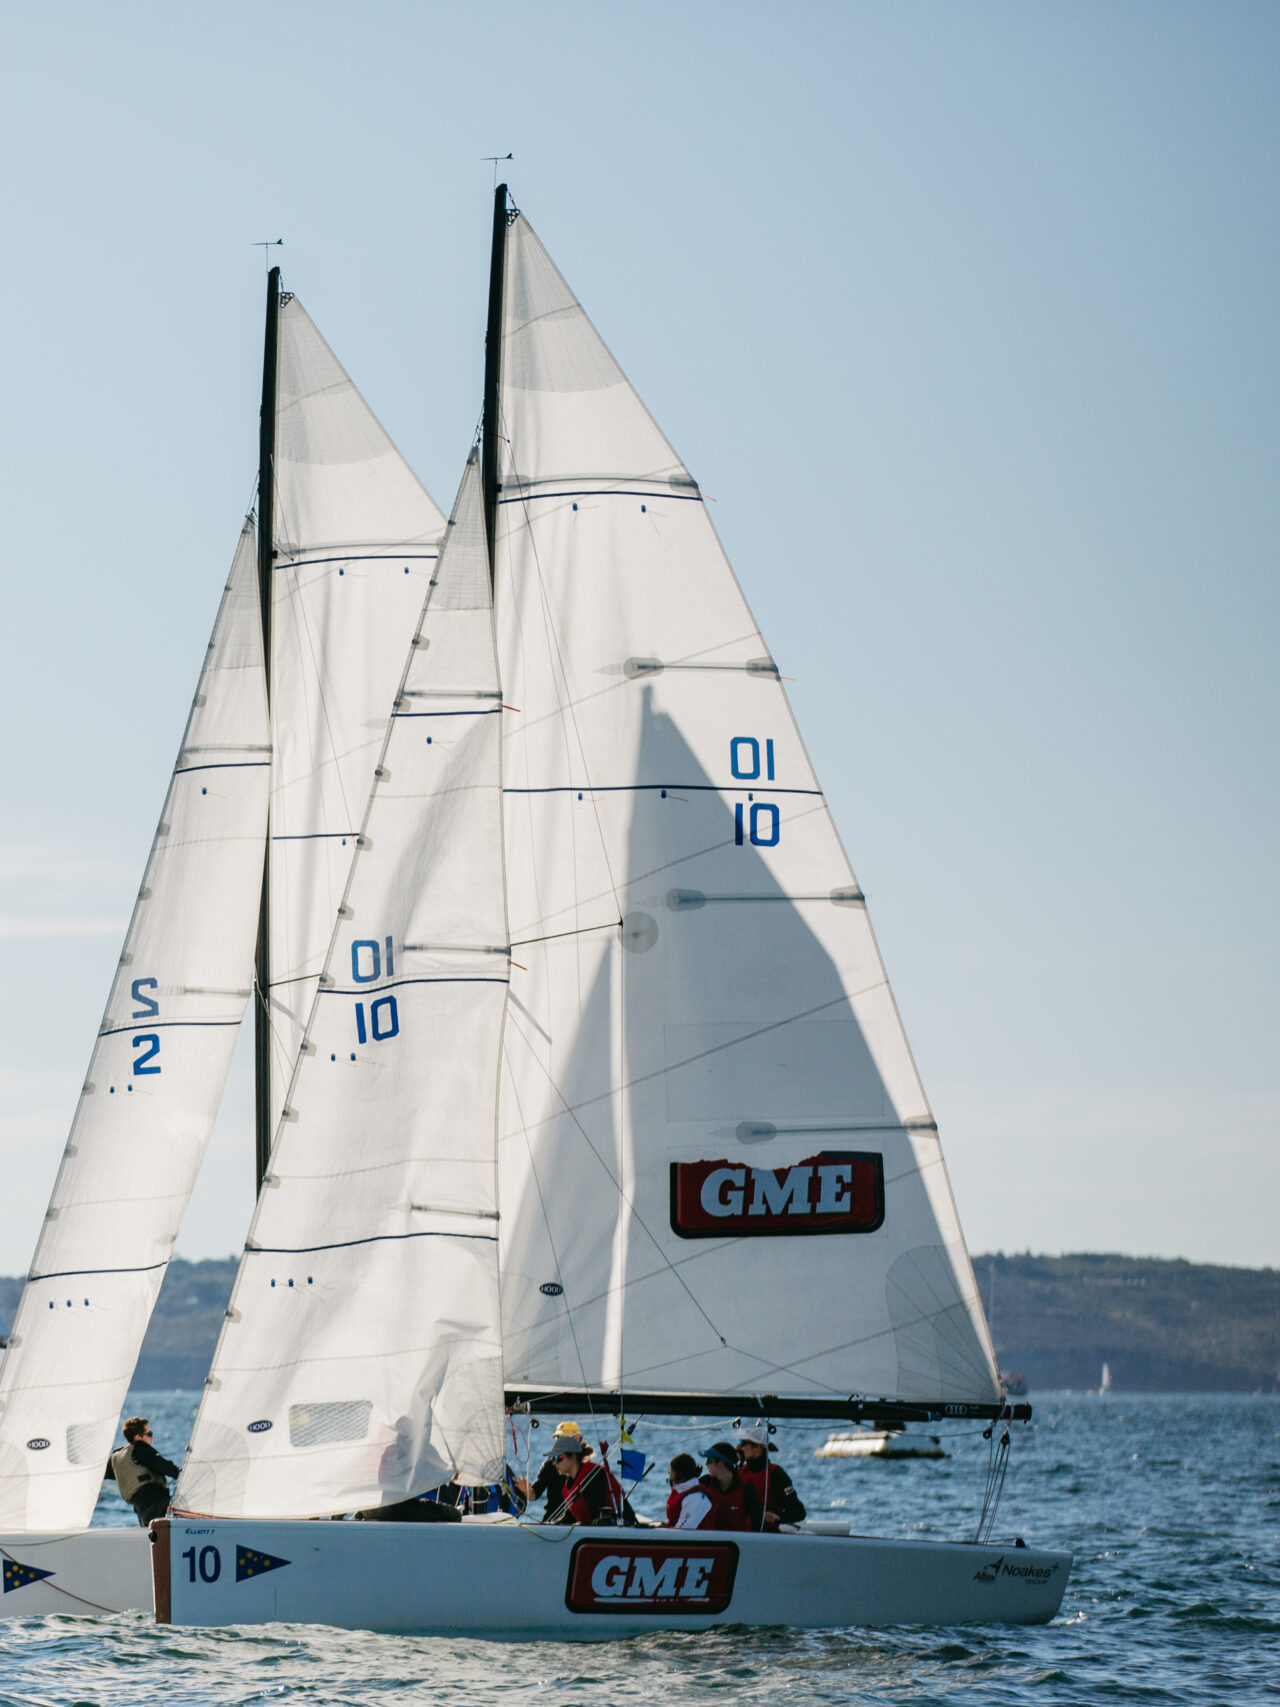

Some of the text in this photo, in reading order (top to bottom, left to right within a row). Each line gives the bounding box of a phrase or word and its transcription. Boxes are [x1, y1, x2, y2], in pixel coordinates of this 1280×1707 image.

[734, 802, 780, 847] 10
[355, 995, 400, 1044] 10
[132, 1033, 162, 1076] 2
[700, 1164, 853, 1218] GME
[182, 1545, 222, 1583] 10
[591, 1555, 715, 1597] GME
